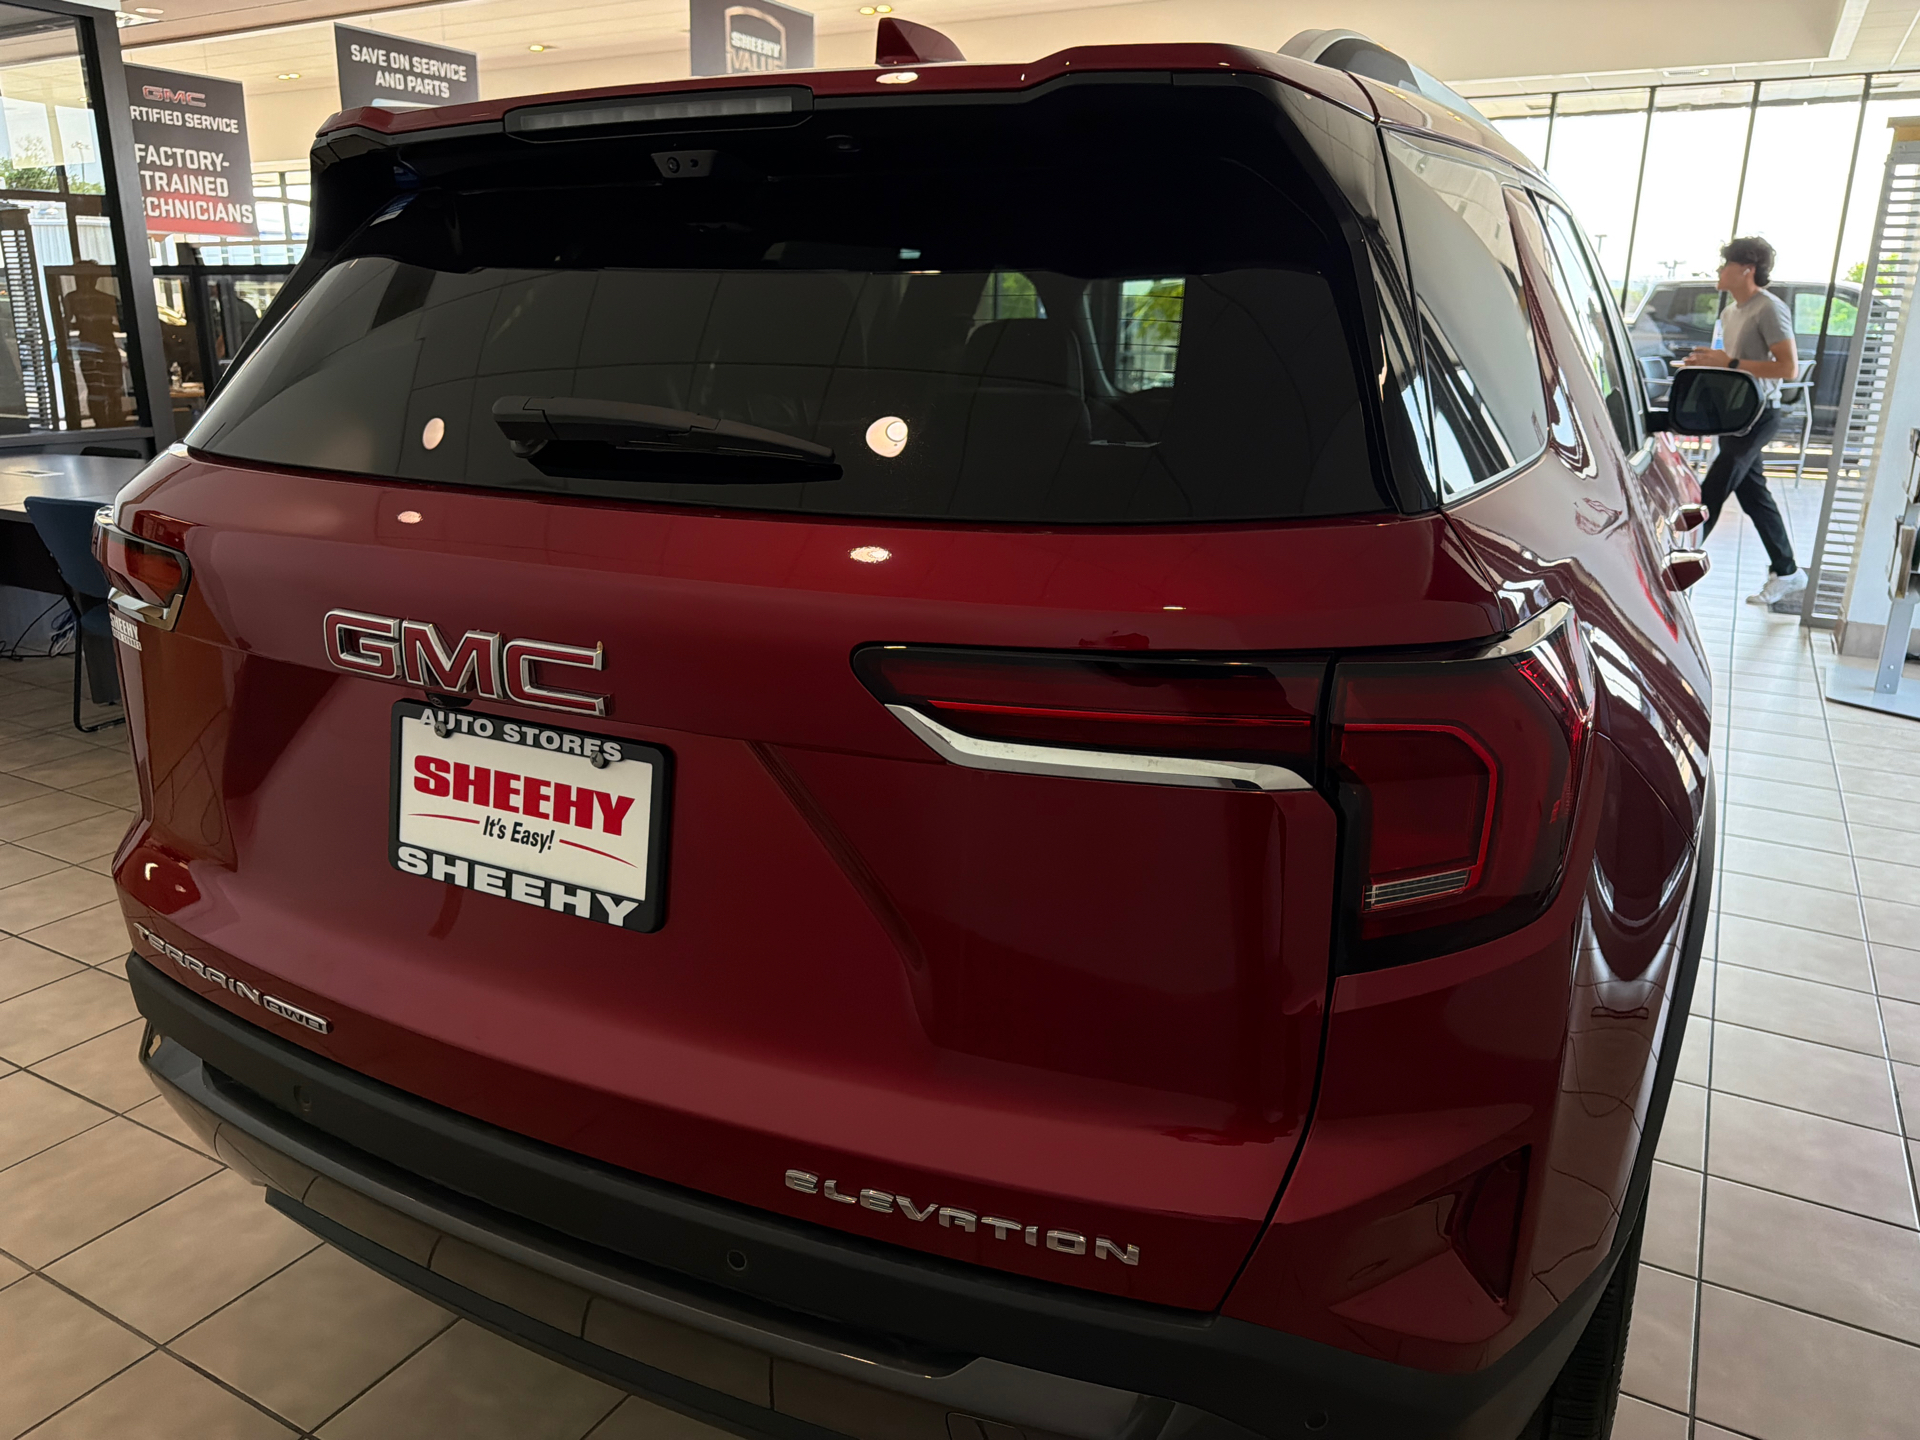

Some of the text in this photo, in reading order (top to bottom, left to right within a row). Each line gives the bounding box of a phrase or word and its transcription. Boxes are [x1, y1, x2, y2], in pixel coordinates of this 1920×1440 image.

[350, 44, 467, 82] SAVE ON SERVICE
[731, 31, 781, 58] SHEEHY
[142, 85, 207, 108] GMC
[375, 70, 450, 98] AND PARTS
[184, 113, 240, 133] SERVICE
[134, 143, 230, 172] FACTORY-
[140, 170, 230, 197] TRAINED
[109, 612, 139, 641] SHEEHY
[324, 608, 607, 717] GMC
[419, 708, 622, 762] AUTO STORES
[413, 754, 636, 837] SHEEHY
[482, 815, 555, 854] It's Easy!
[397, 846, 640, 927] SHEEHY
[133, 922, 328, 1034] TERRAIN AWD
[785, 1169, 1140, 1266] ELEVATION
